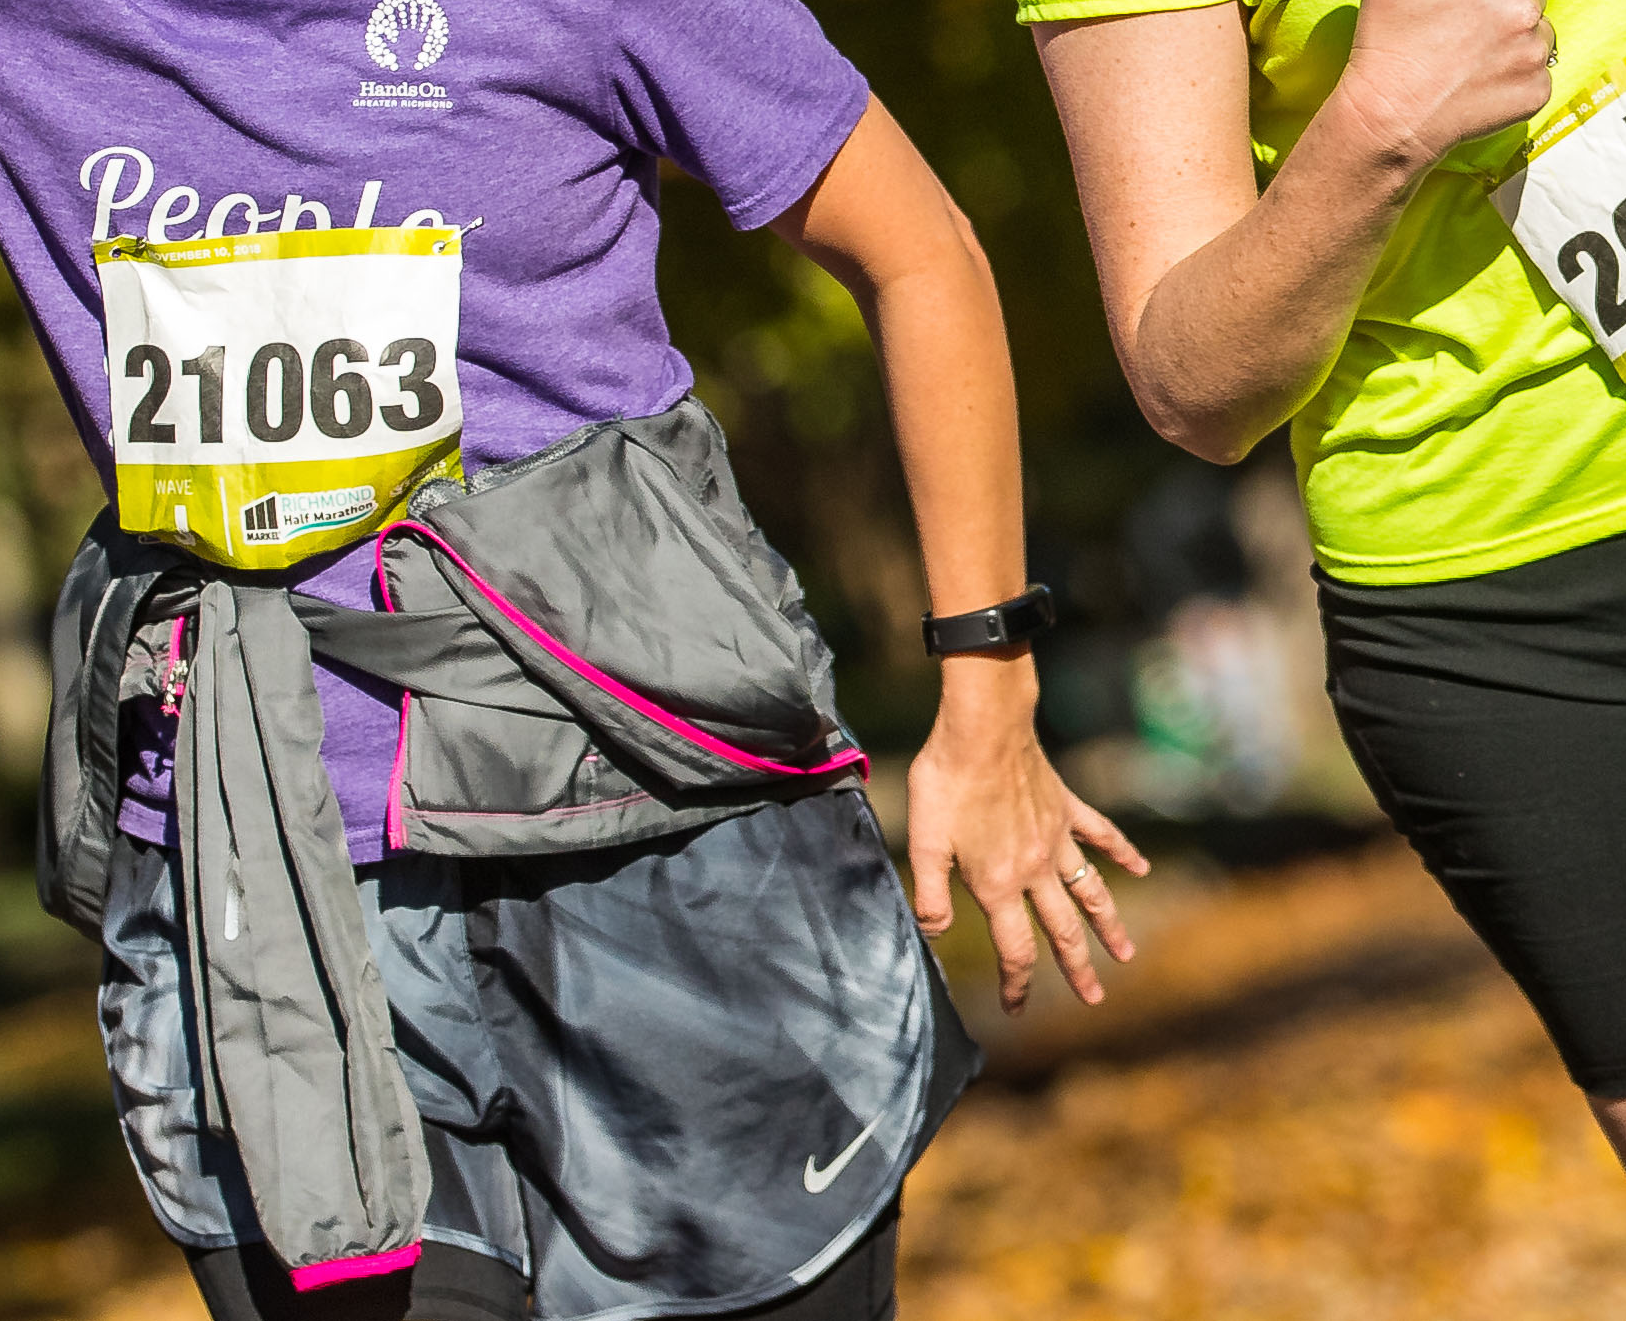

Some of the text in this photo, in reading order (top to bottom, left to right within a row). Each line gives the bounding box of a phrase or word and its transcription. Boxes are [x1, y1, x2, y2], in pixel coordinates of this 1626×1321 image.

[359, 81, 448, 98] HandsOn
[352, 99, 454, 109] GREATER RICHMOND
[124, 337, 445, 445] 21063
[155, 479, 194, 495] WAVE
[281, 488, 372, 513] RICHMOND
[284, 502, 374, 526] Half Marathon
[246, 532, 281, 541] MARKEL
